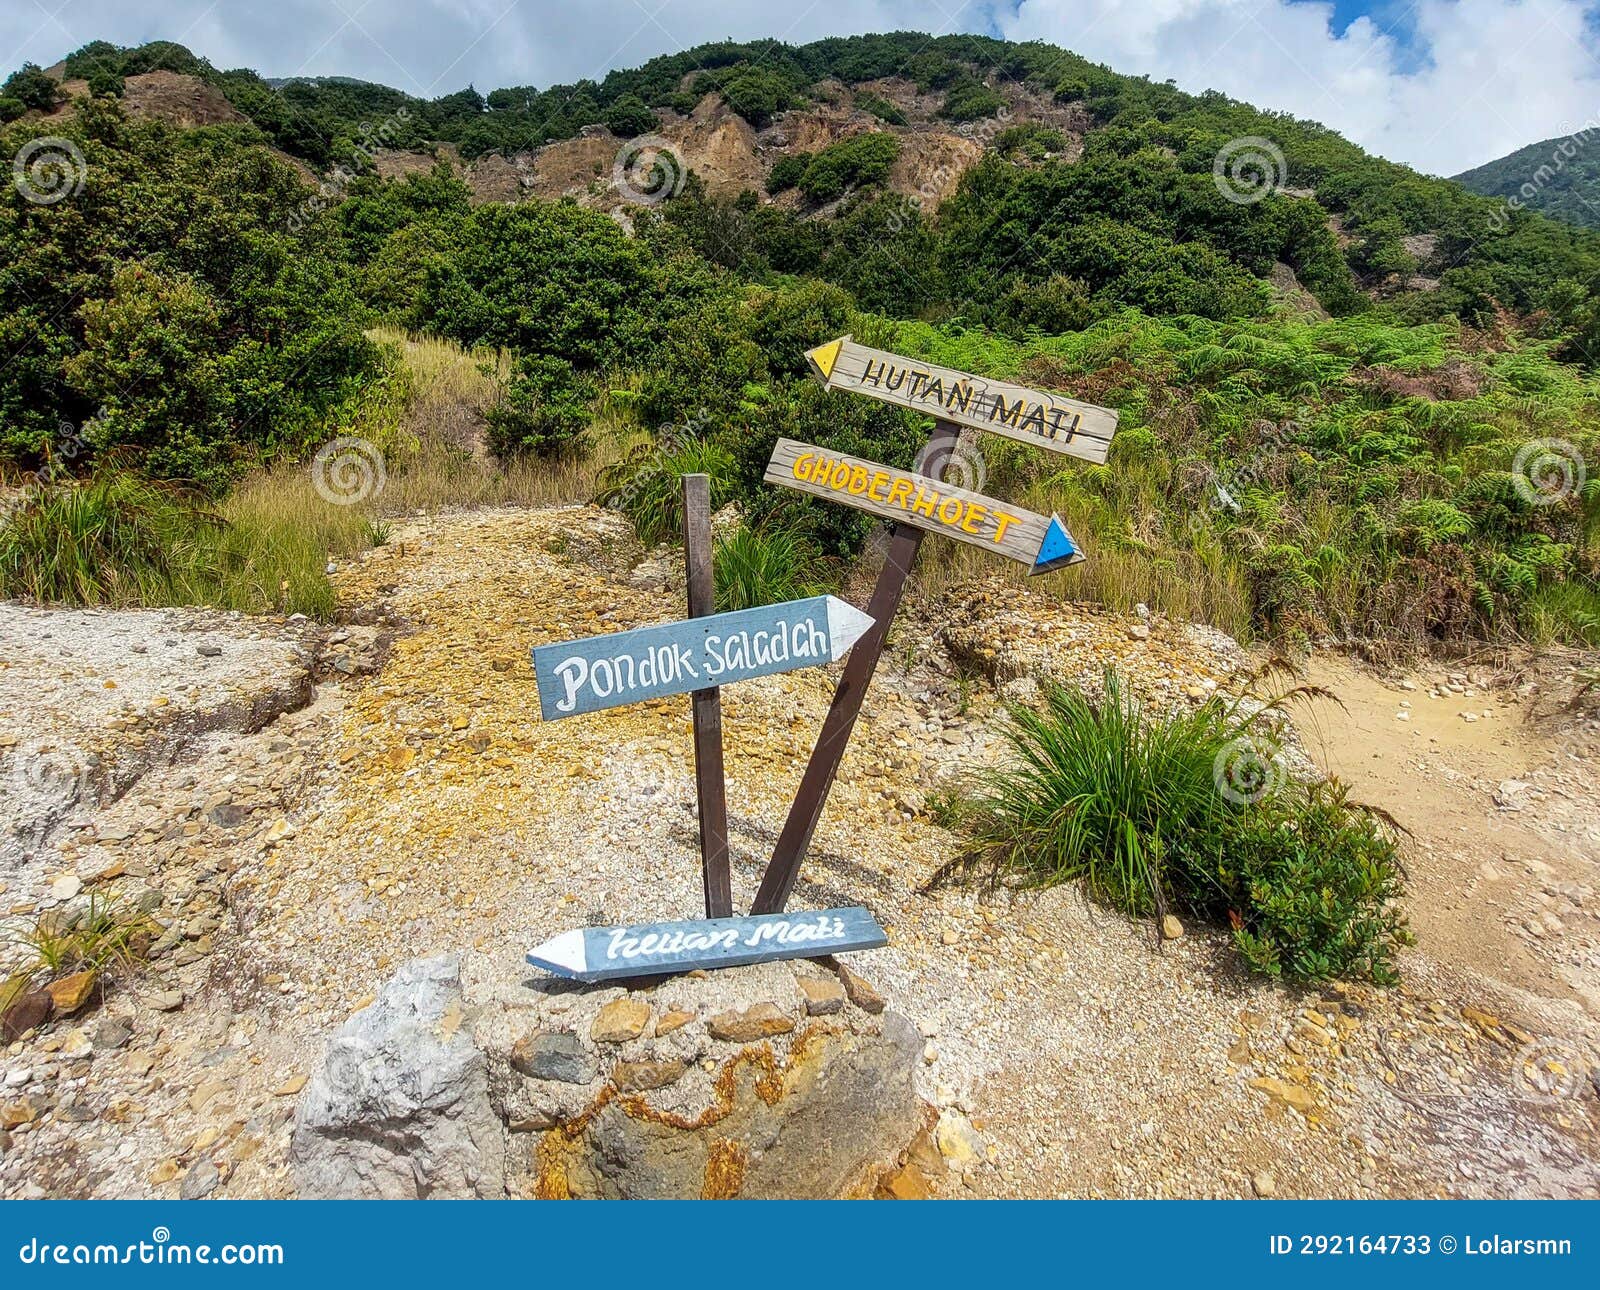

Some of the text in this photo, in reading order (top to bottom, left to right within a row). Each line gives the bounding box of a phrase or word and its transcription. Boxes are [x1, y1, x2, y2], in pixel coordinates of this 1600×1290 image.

[861, 359, 1083, 444] HUTAN MATI
[792, 453, 1024, 543] GHOBERHOET
